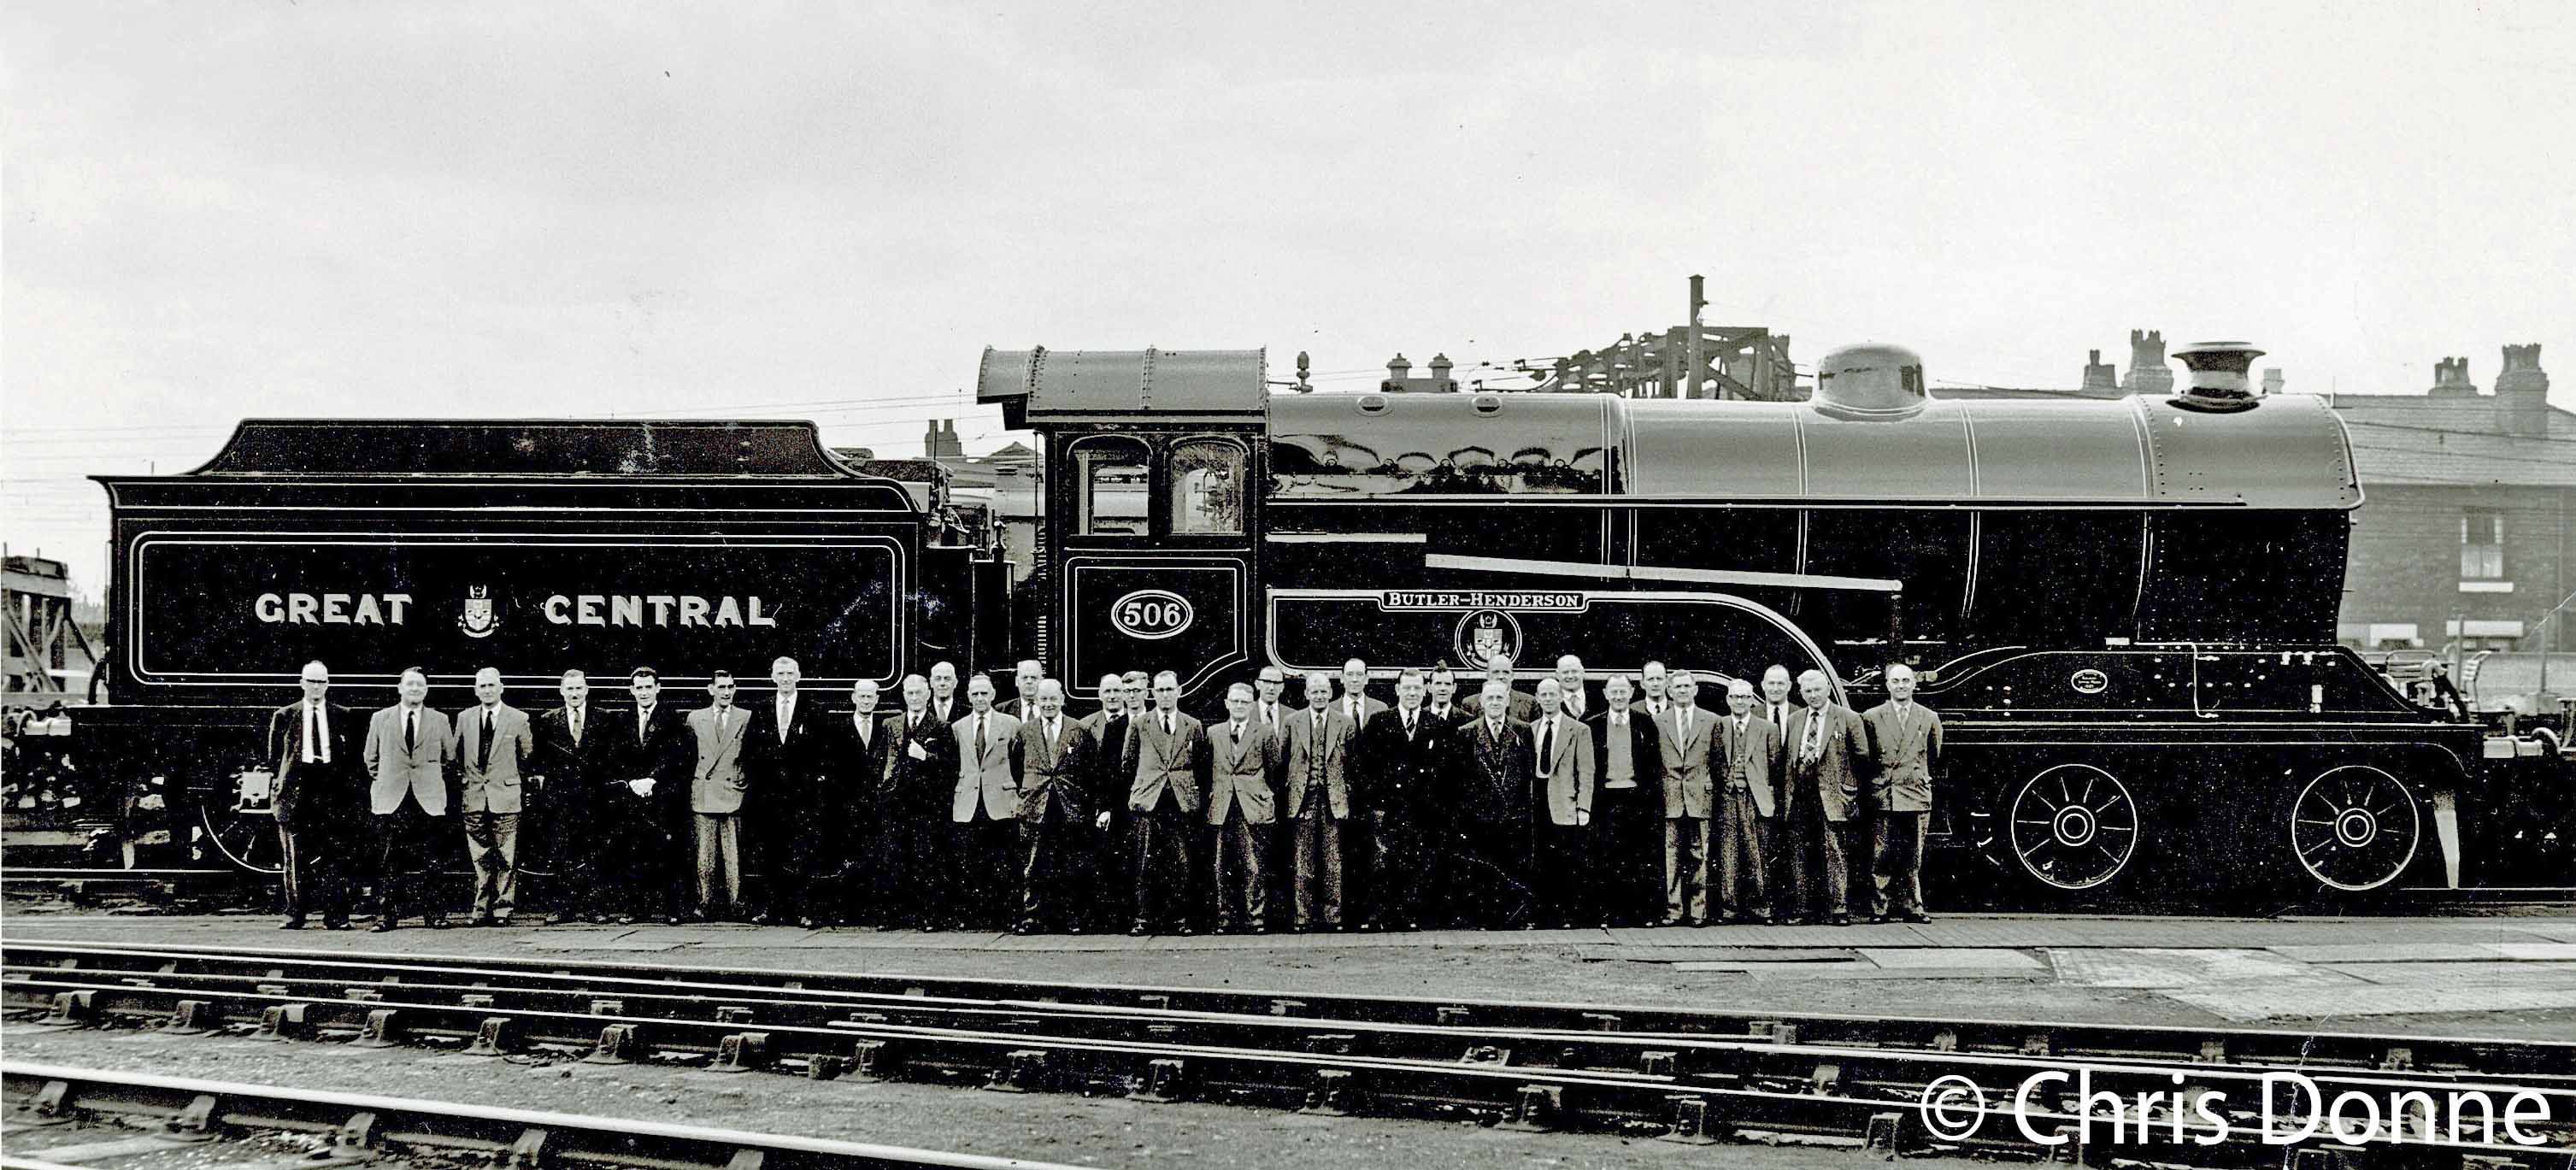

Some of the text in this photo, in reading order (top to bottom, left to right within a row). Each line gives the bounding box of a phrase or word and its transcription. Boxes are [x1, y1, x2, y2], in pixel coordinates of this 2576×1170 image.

[255, 592, 775, 629] GREAT CENTRAL
[1123, 602, 1181, 626] 506
